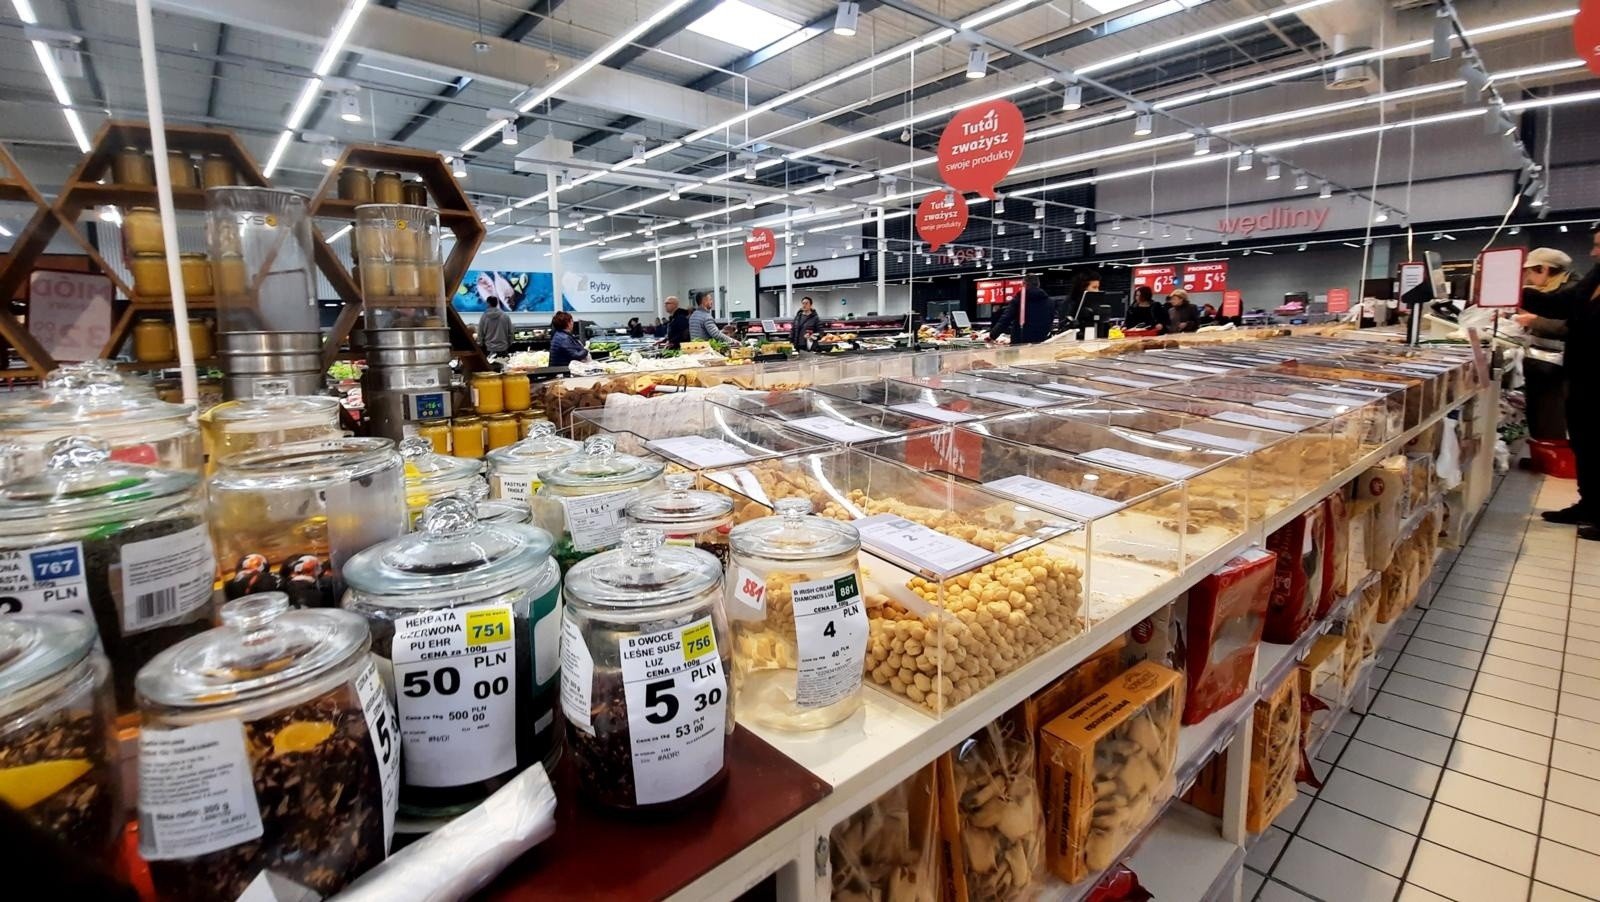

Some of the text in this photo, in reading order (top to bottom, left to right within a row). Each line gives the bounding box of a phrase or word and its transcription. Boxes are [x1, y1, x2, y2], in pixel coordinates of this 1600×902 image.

[962, 114, 999, 136] Tutaj
[952, 132, 1009, 155] zważysz
[945, 149, 1014, 172] swoje produkty
[1217, 207, 1330, 235] wędliny
[794, 264, 818, 280] drób
[590, 281, 611, 292] Ryby
[590, 294, 646, 305] Sałatki rybne
[37, 560, 74, 576] 767
[43, 587, 78, 602] PLN
[794, 590, 835, 603] DIAMONDS LUZ
[799, 587, 815, 595] IRISH
[815, 584, 834, 593] CREAM
[839, 584, 855, 597] 881
[843, 605, 859, 618] PLN
[406, 612, 456, 628] HERBATA
[400, 624, 462, 640] CZERWONA
[472, 622, 504, 639] 751
[823, 620, 837, 638] 4
[410, 637, 451, 650] PU EHR
[629, 632, 673, 648] B OWOCE
[687, 635, 711, 654] 756
[421, 651, 448, 660] CENA
[465, 645, 487, 654] 100g
[624, 641, 681, 660] LEŚNE SUSZ
[474, 652, 507, 668] PLN
[645, 658, 664, 668] LUZ
[646, 658, 701, 678] CENA za 100g
[691, 662, 717, 682] PLN
[403, 667, 460, 698] 50
[473, 676, 509, 700] 00
[645, 678, 680, 725] 5
[693, 687, 722, 712] 30
[448, 710, 469, 721] 500
[472, 705, 487, 713] PLN
[472, 713, 485, 722] 00
[675, 724, 691, 739] 53
[694, 724, 704, 734] 00
